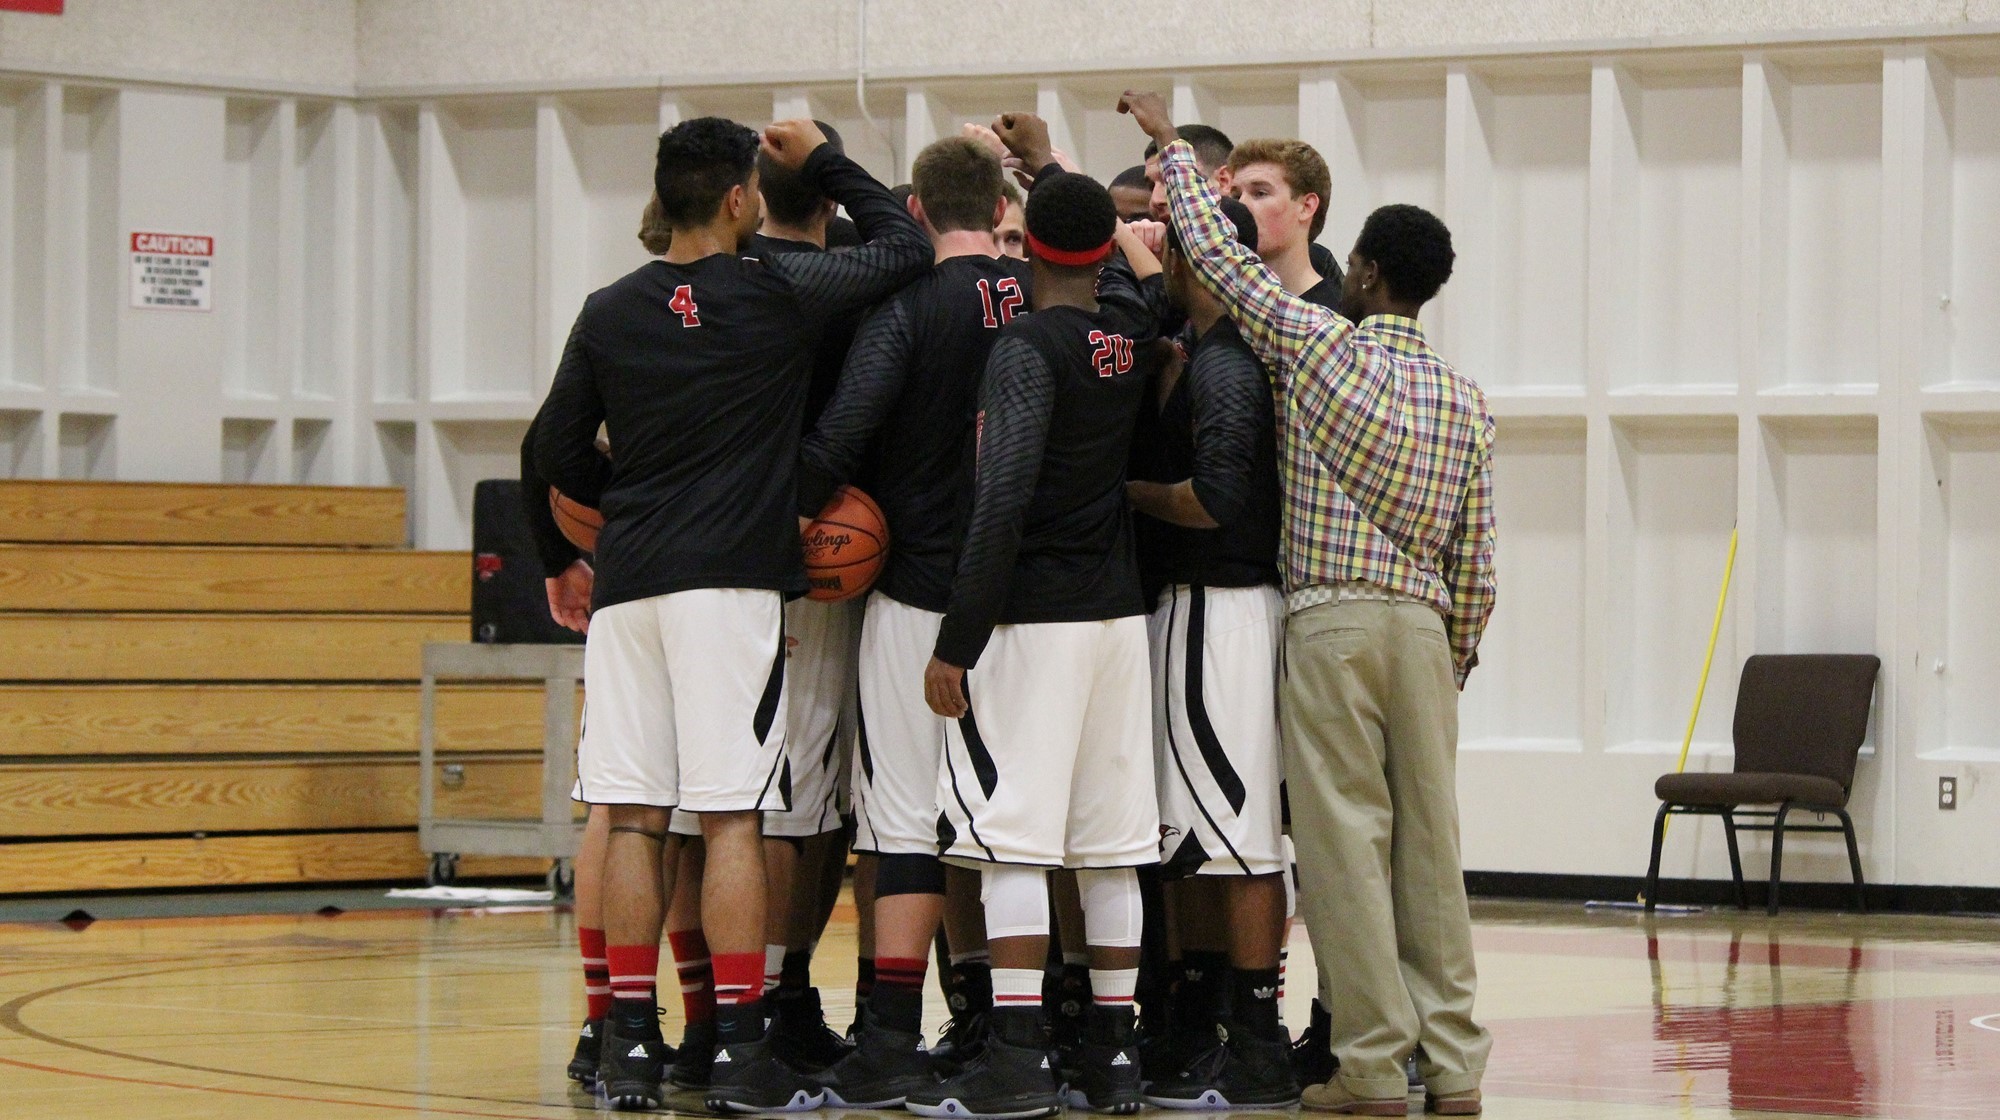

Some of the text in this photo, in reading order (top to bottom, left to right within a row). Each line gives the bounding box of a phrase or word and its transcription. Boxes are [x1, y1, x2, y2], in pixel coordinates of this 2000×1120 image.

[136, 234, 209, 254] CAUTION
[668, 285, 701, 328] 4
[977, 277, 1028, 328] 12
[1088, 330, 1133, 378] 20
[801, 528, 853, 556] wlings
